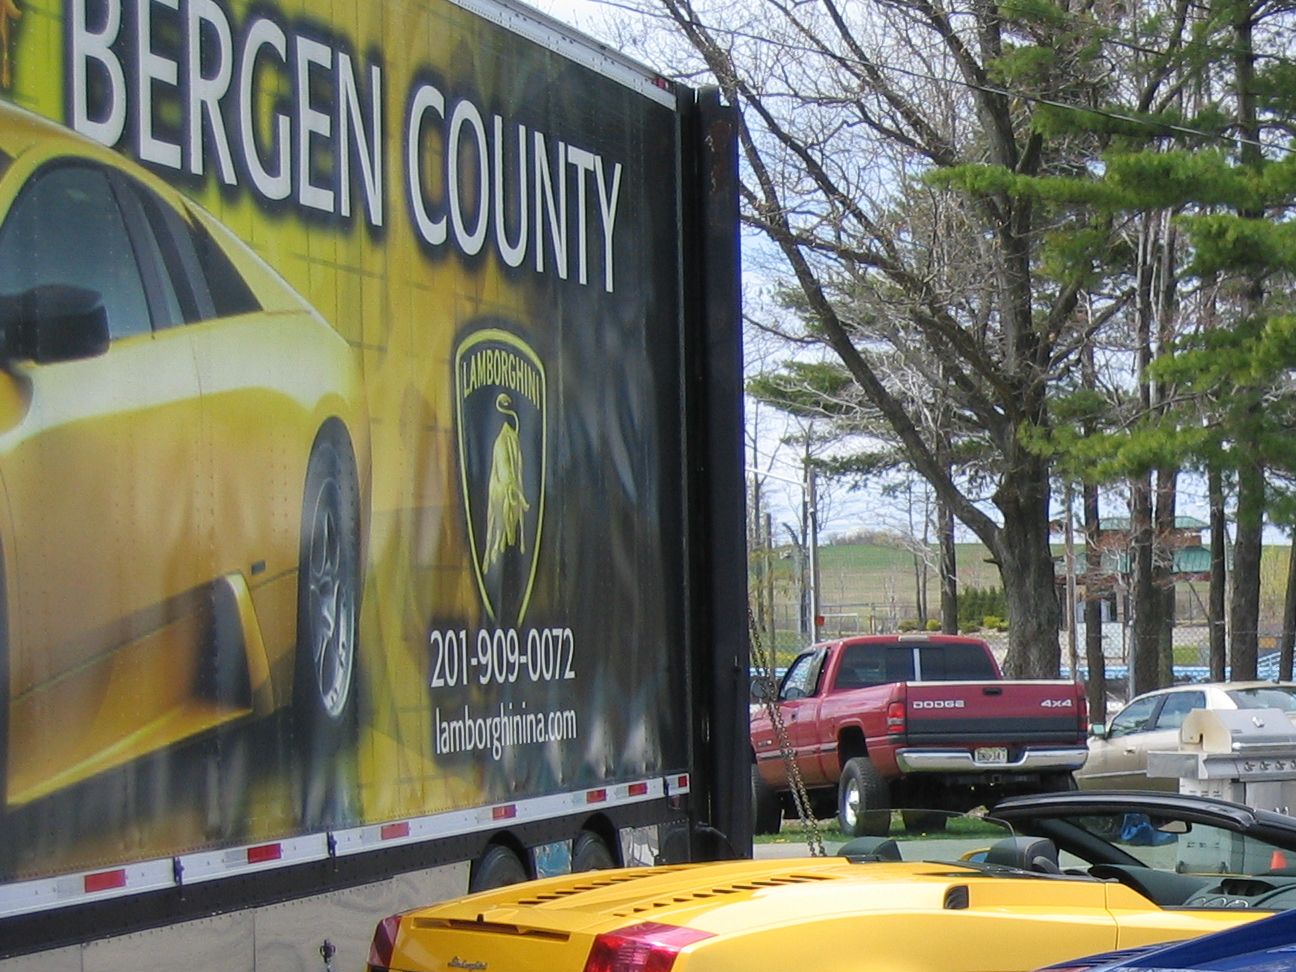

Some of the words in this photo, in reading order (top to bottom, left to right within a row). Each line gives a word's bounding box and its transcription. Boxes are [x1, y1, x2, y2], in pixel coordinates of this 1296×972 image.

[73, 0, 383, 227] BERGEN
[408, 84, 624, 292] COUNTY
[463, 349, 540, 410] LAMBORGHINI
[430, 627, 576, 688] 201-909-0072
[435, 701, 577, 761] lamborghinina.com
[912, 700, 965, 709] DODGE
